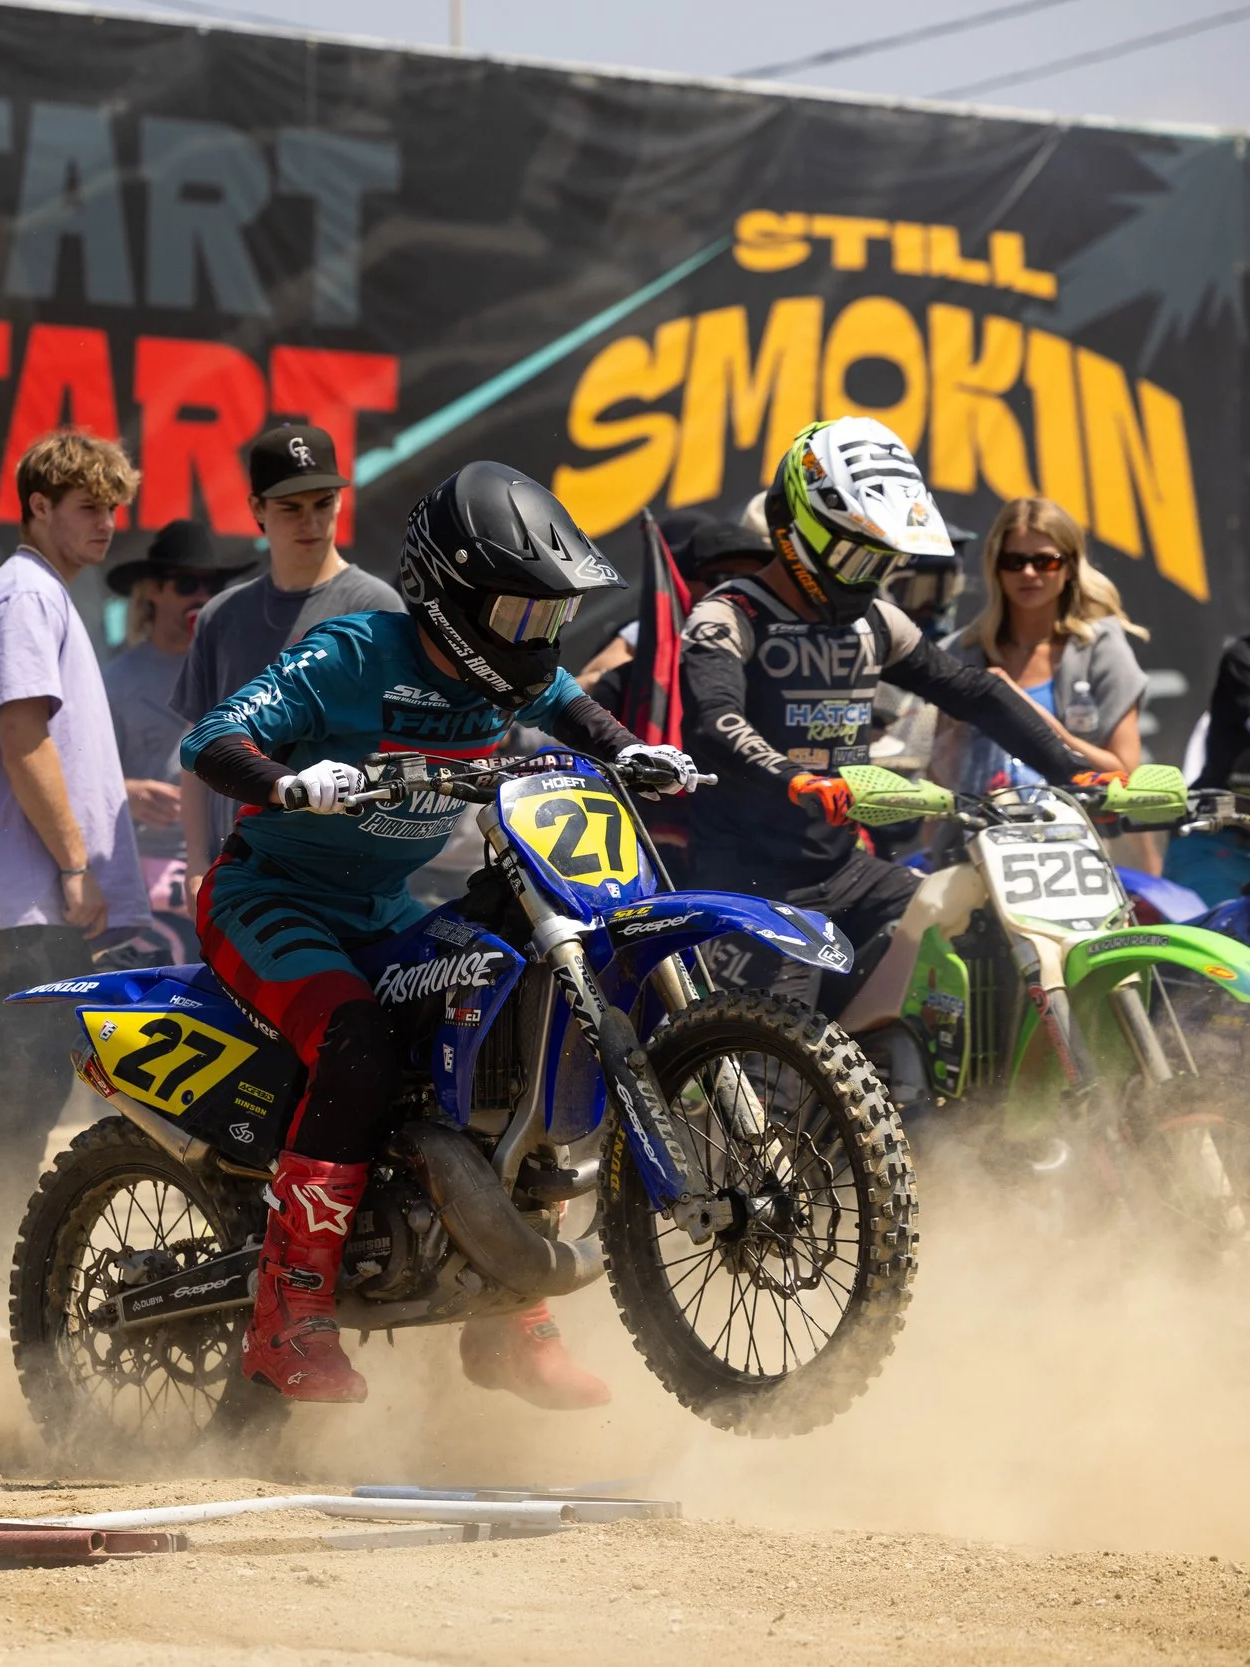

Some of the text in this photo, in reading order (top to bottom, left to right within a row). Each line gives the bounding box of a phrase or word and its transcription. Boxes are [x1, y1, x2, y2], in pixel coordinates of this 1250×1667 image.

[732, 209, 1058, 301] STILL
[289, 437, 316, 467] CR
[553, 296, 1211, 603] SMOKIN
[383, 693, 451, 709] SIMI VALLEY CYCLES
[786, 702, 871, 727] HATCH
[472, 754, 557, 769] RENTHA
[541, 776, 586, 790] HOEFT
[409, 790, 469, 814] YAMA
[535, 797, 624, 877] 27
[1001, 849, 1110, 904] 526
[25, 981, 100, 995] DUNLOP
[374, 951, 504, 1007] FASTHOUSE
[169, 994, 203, 1008] HOEFT
[113, 1018, 227, 1102] 27
[234, 1097, 267, 1116] HINSON
[140, 1295, 164, 1308] DUBYA
